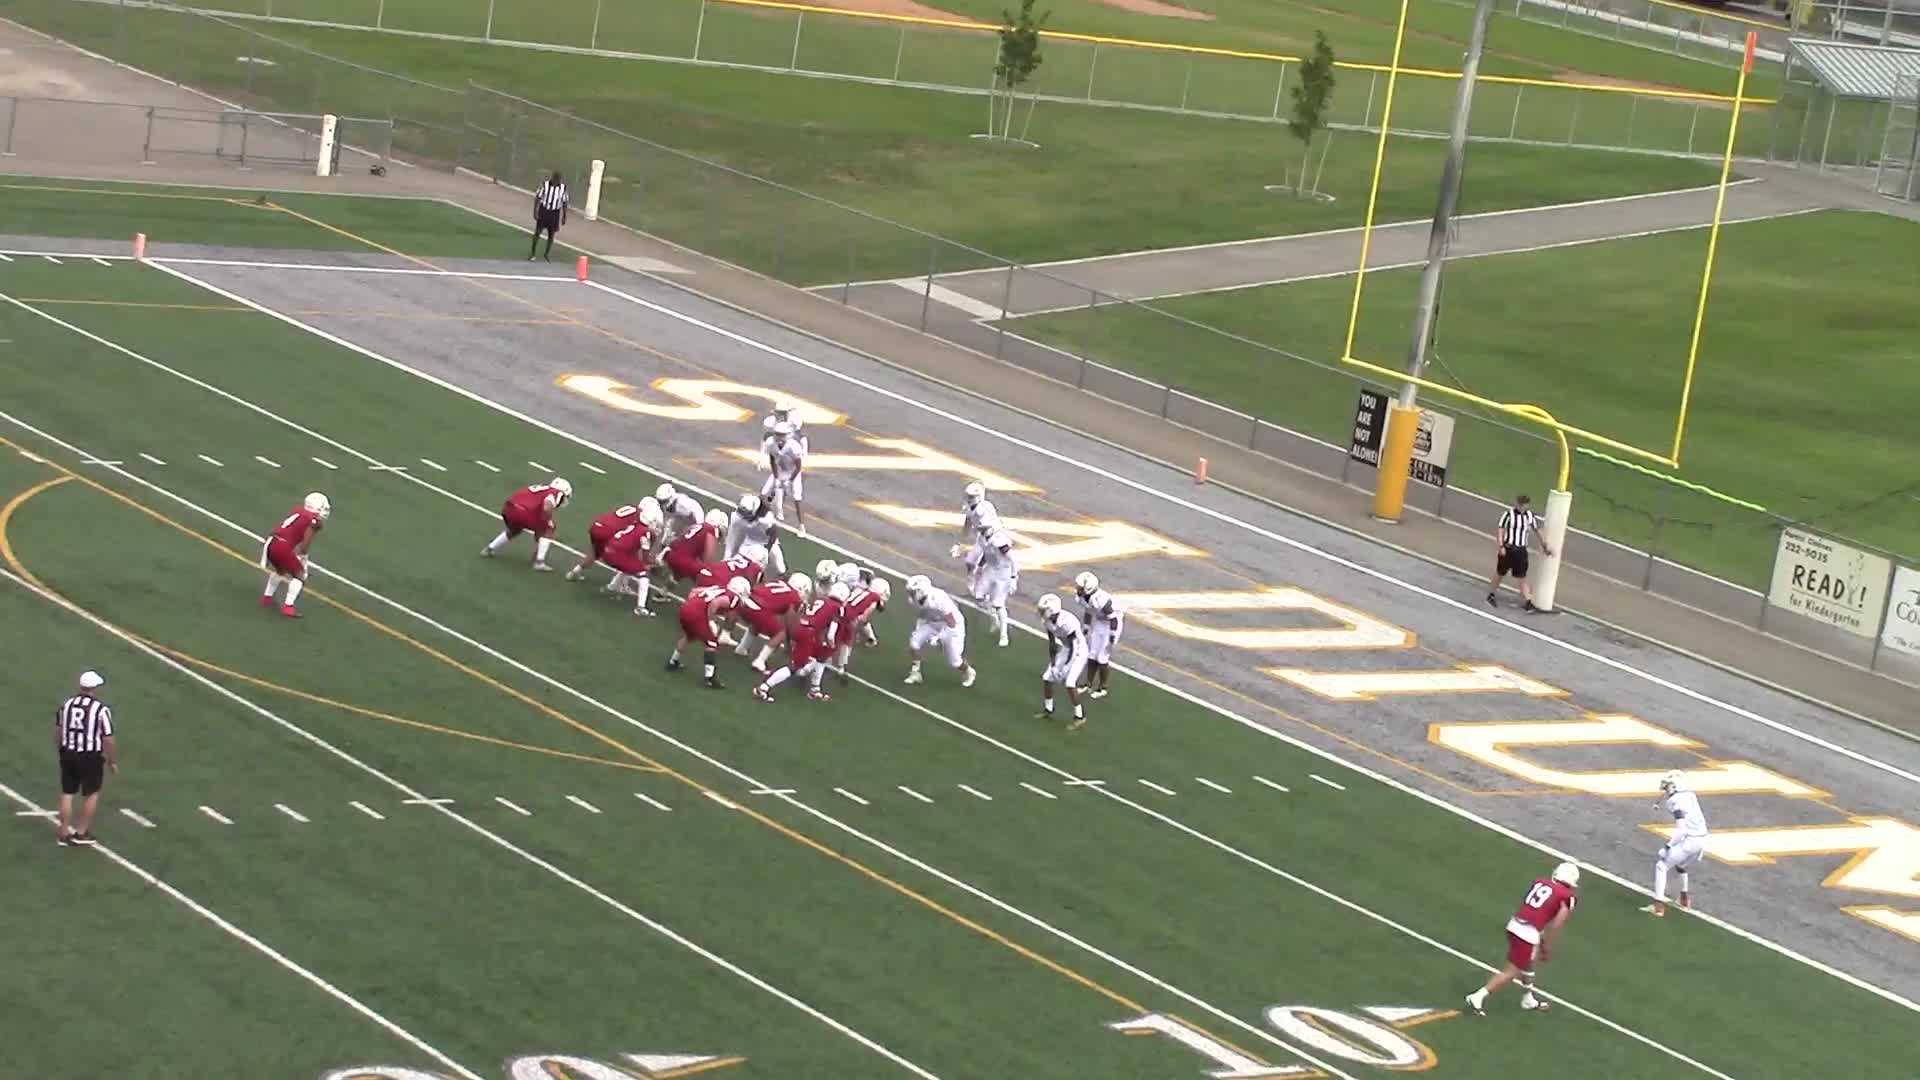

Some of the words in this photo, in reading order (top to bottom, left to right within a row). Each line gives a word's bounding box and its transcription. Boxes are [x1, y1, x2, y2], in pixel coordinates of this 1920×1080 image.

[1360, 393, 1377, 409] YOU
[1357, 411, 1372, 426] ARE
[1355, 427, 1371, 443] NOT
[69, 706, 85, 730] R
[1524, 881, 1553, 909] 19
